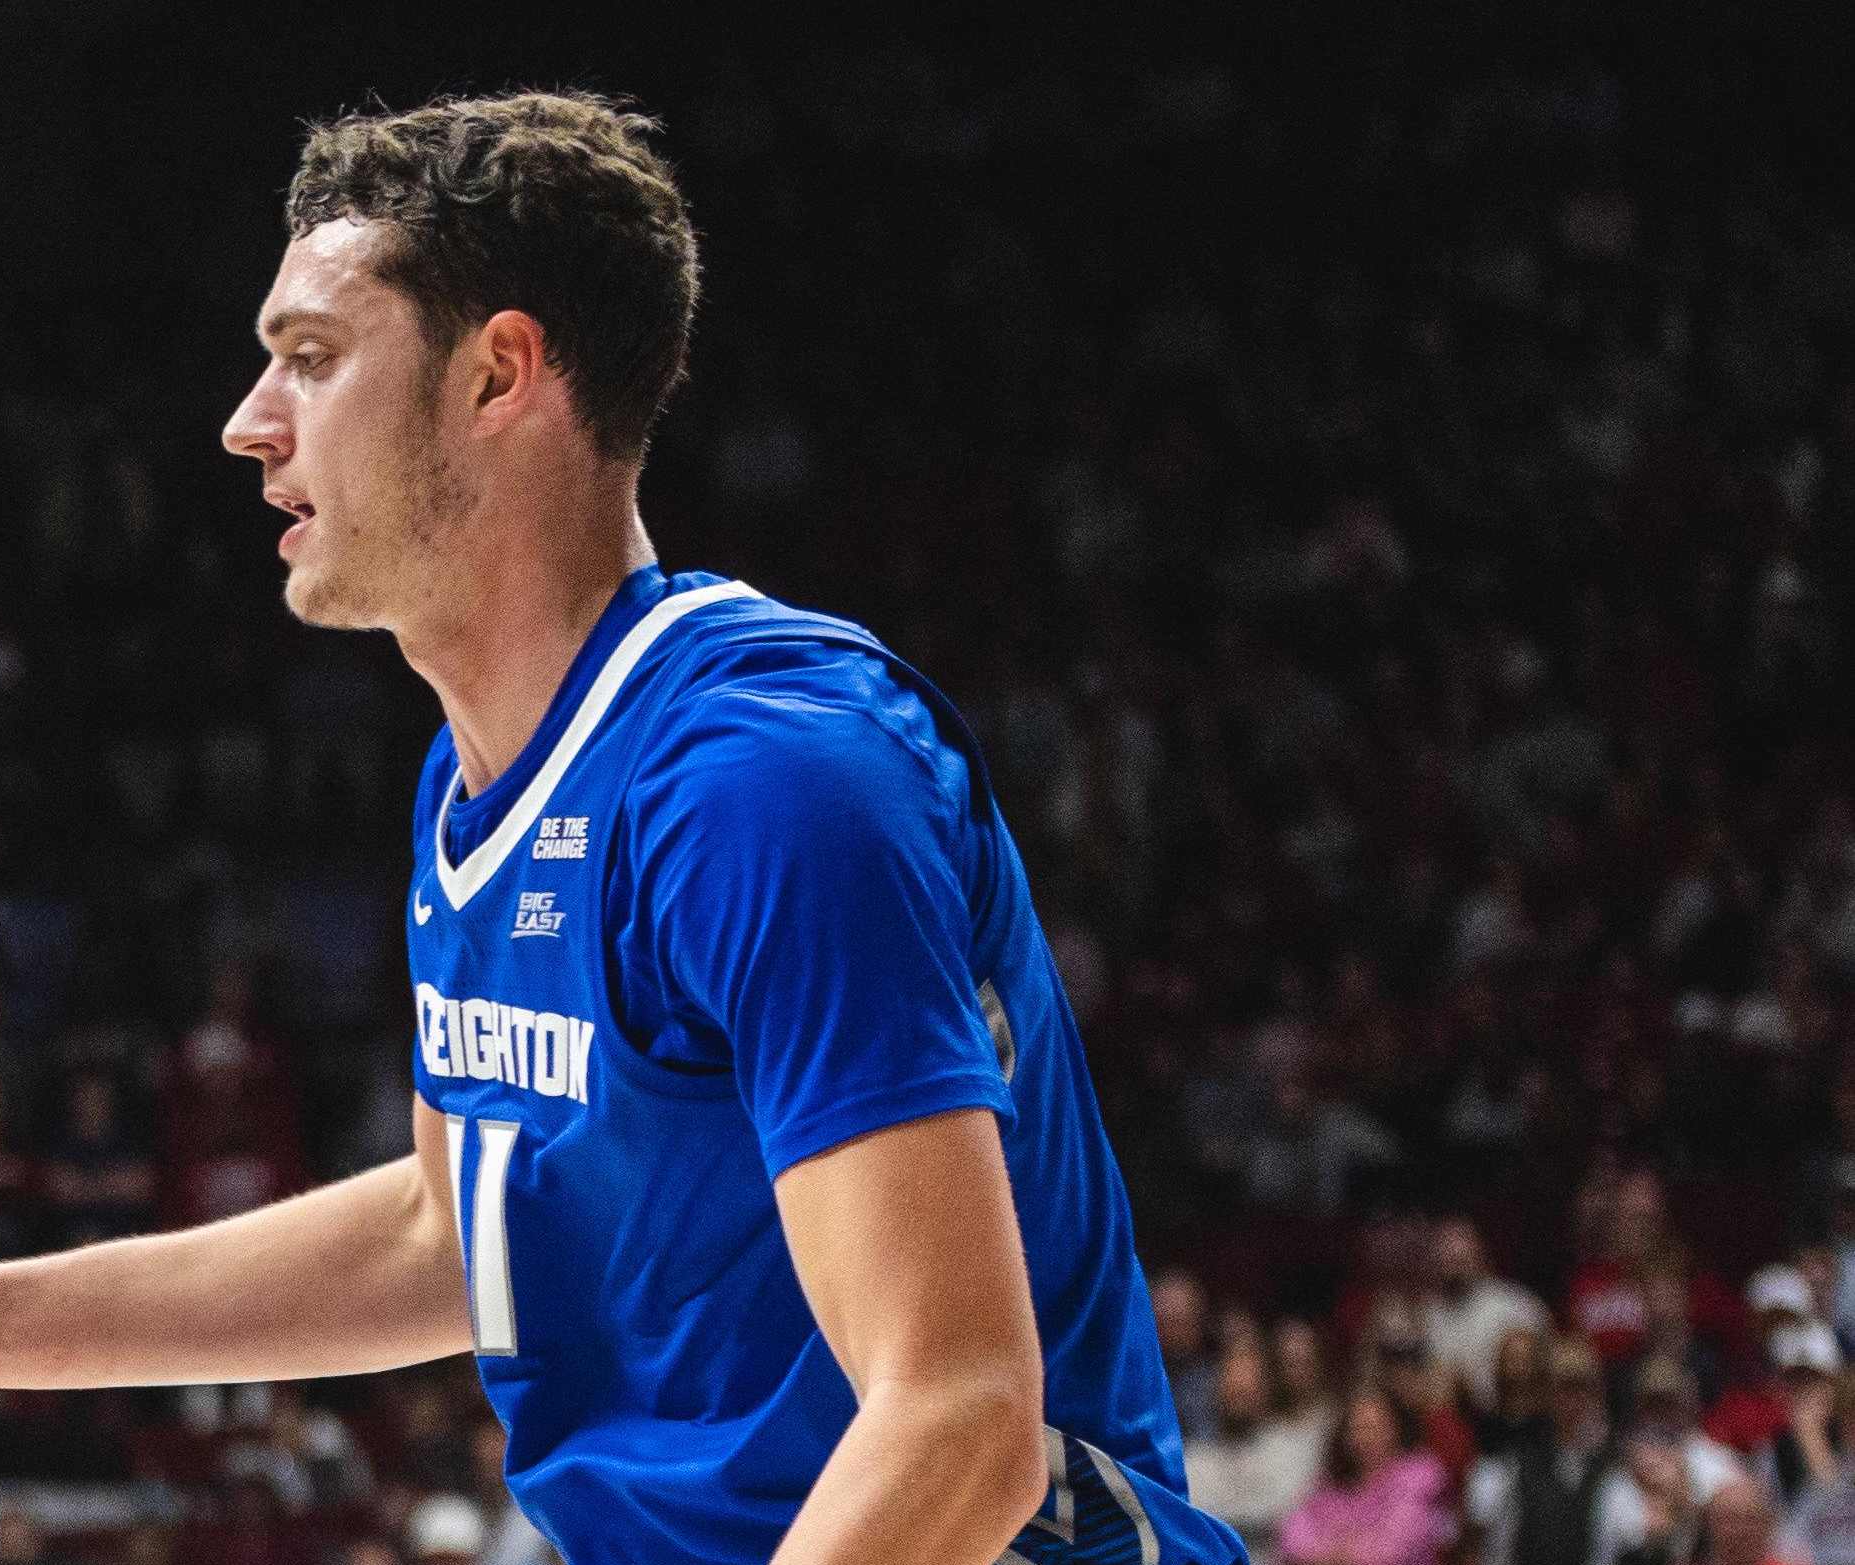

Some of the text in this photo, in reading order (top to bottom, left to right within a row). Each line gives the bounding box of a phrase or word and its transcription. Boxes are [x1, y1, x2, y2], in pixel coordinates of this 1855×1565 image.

[538, 816, 590, 839] BE THE
[531, 838, 590, 859] CHANGE
[514, 891, 567, 930] BIG EAST
